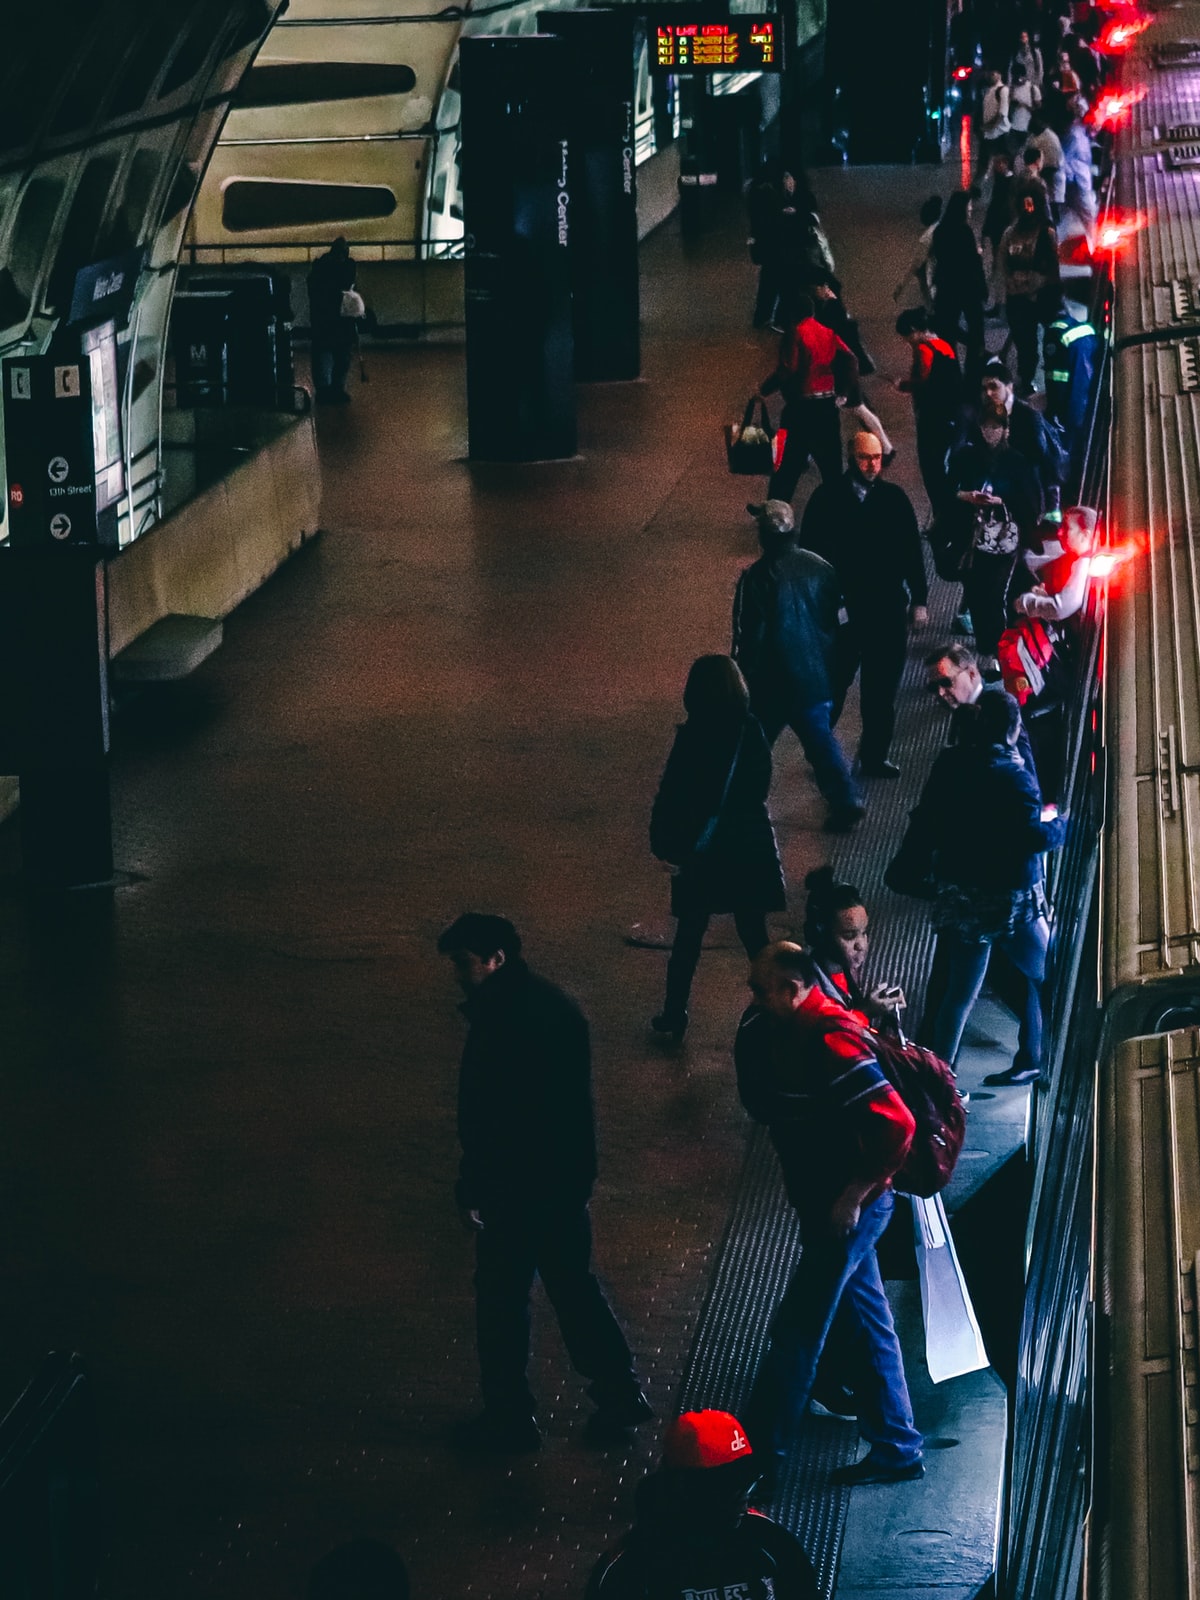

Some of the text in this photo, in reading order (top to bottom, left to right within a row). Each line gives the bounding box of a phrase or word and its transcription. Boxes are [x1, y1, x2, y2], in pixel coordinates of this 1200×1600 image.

[623, 147, 633, 194] Center
[557, 192, 570, 247] Center
[10, 490, 23, 502] RD
[49, 485, 92, 497] 13th Street
